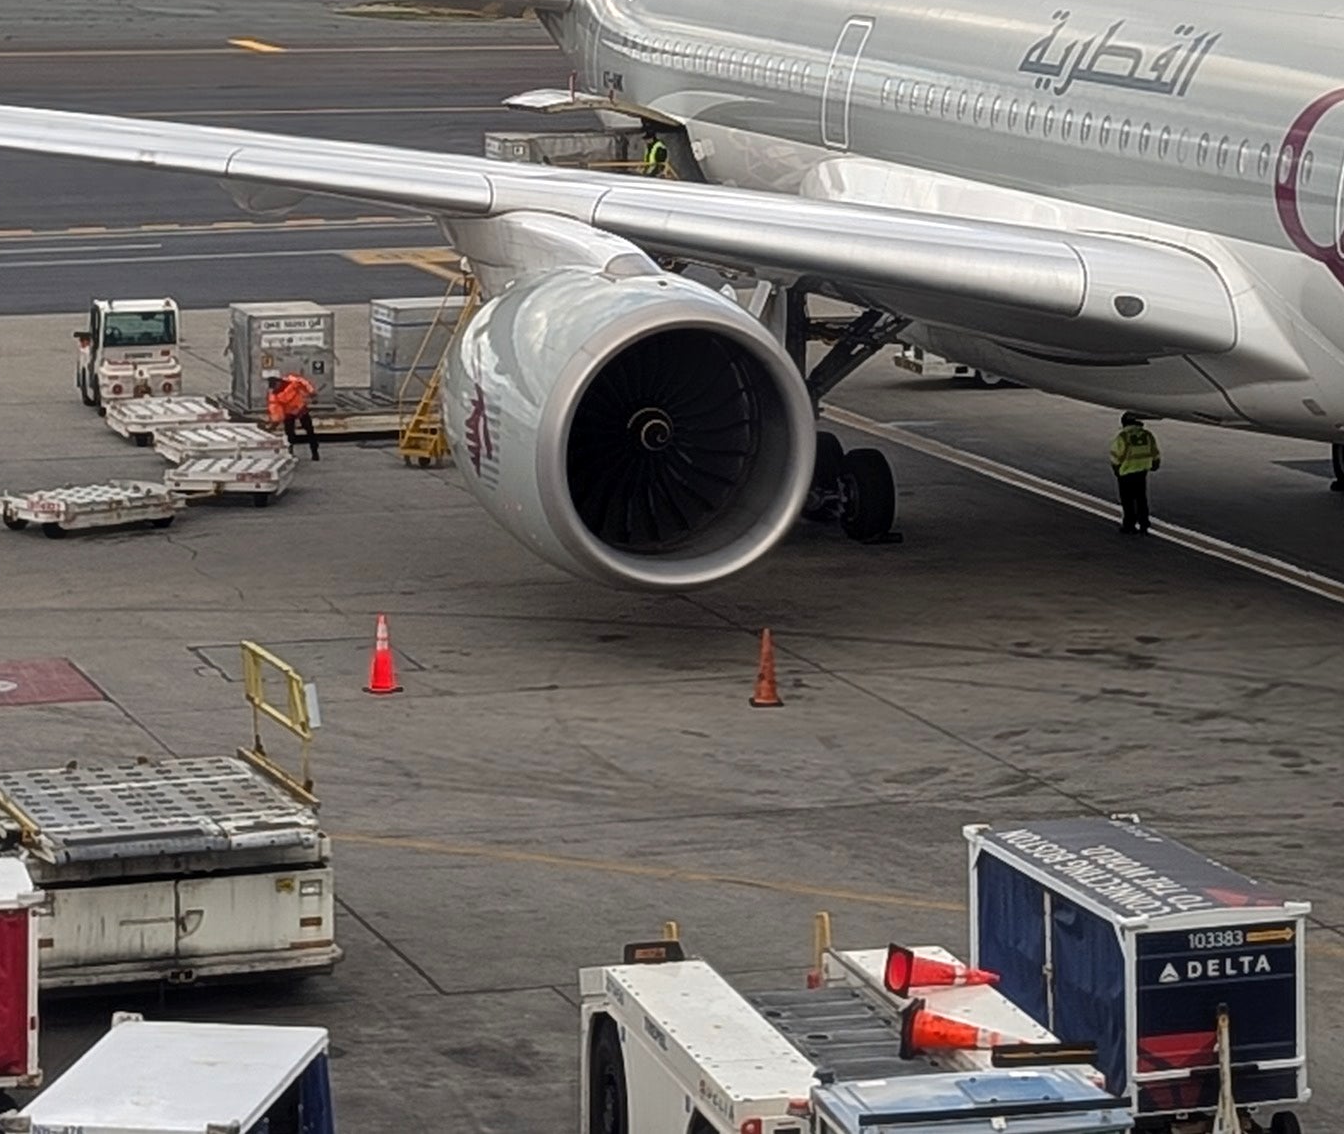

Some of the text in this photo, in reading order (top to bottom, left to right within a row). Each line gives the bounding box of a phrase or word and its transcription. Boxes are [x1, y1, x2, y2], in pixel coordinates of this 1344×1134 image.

[1018, 10, 1222, 96] القطرية
[995, 828, 1077, 867] BOSTON
[1061, 858, 1171, 917] CONNECTING
[1167, 886, 1214, 911] TO
[1188, 929, 1244, 949] 103383
[1187, 955, 1271, 979] DELTA
